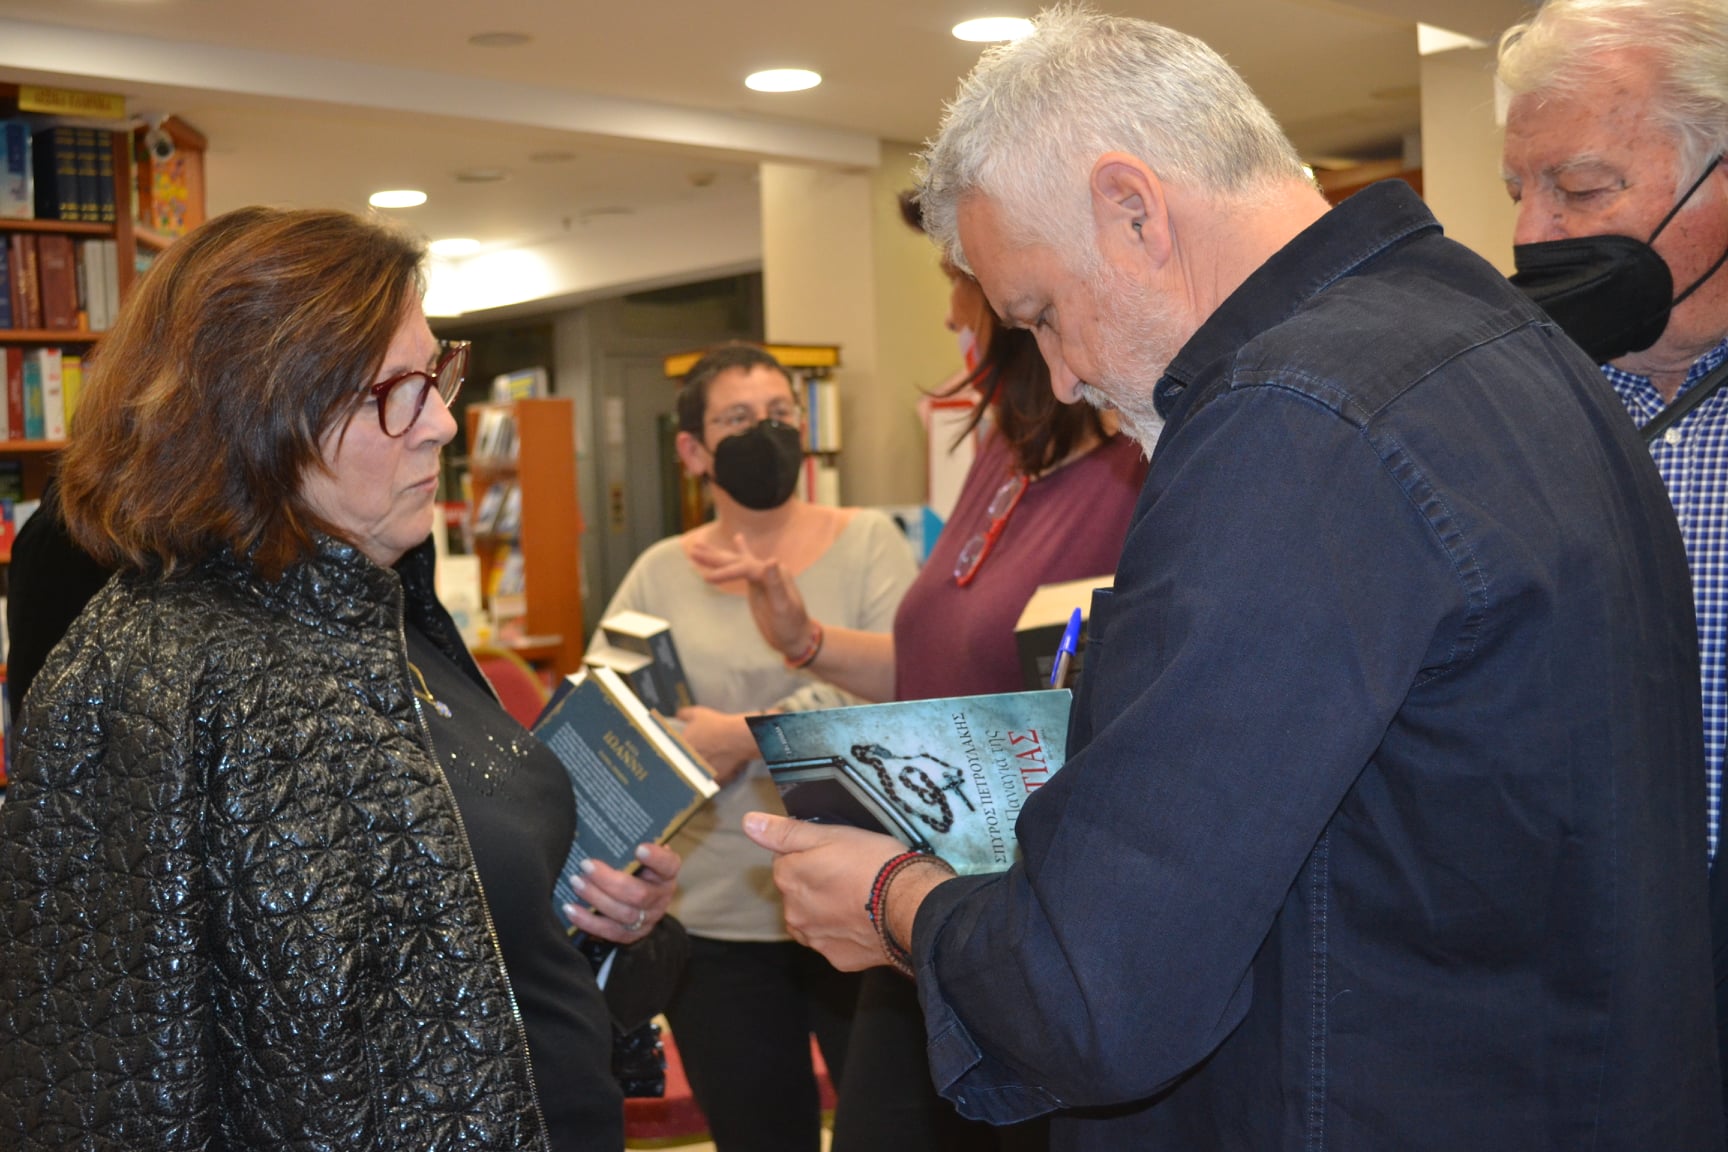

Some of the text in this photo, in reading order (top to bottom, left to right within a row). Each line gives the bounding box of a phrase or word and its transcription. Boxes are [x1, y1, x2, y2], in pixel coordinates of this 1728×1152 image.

[985, 730, 1006, 753] της
[1008, 729, 1049, 793] ΤΙΑΣ
[952, 712, 1007, 864] ΣΠΥΡΟΣ ΠΕΤΡΟΥΛΑΚΗΣ
